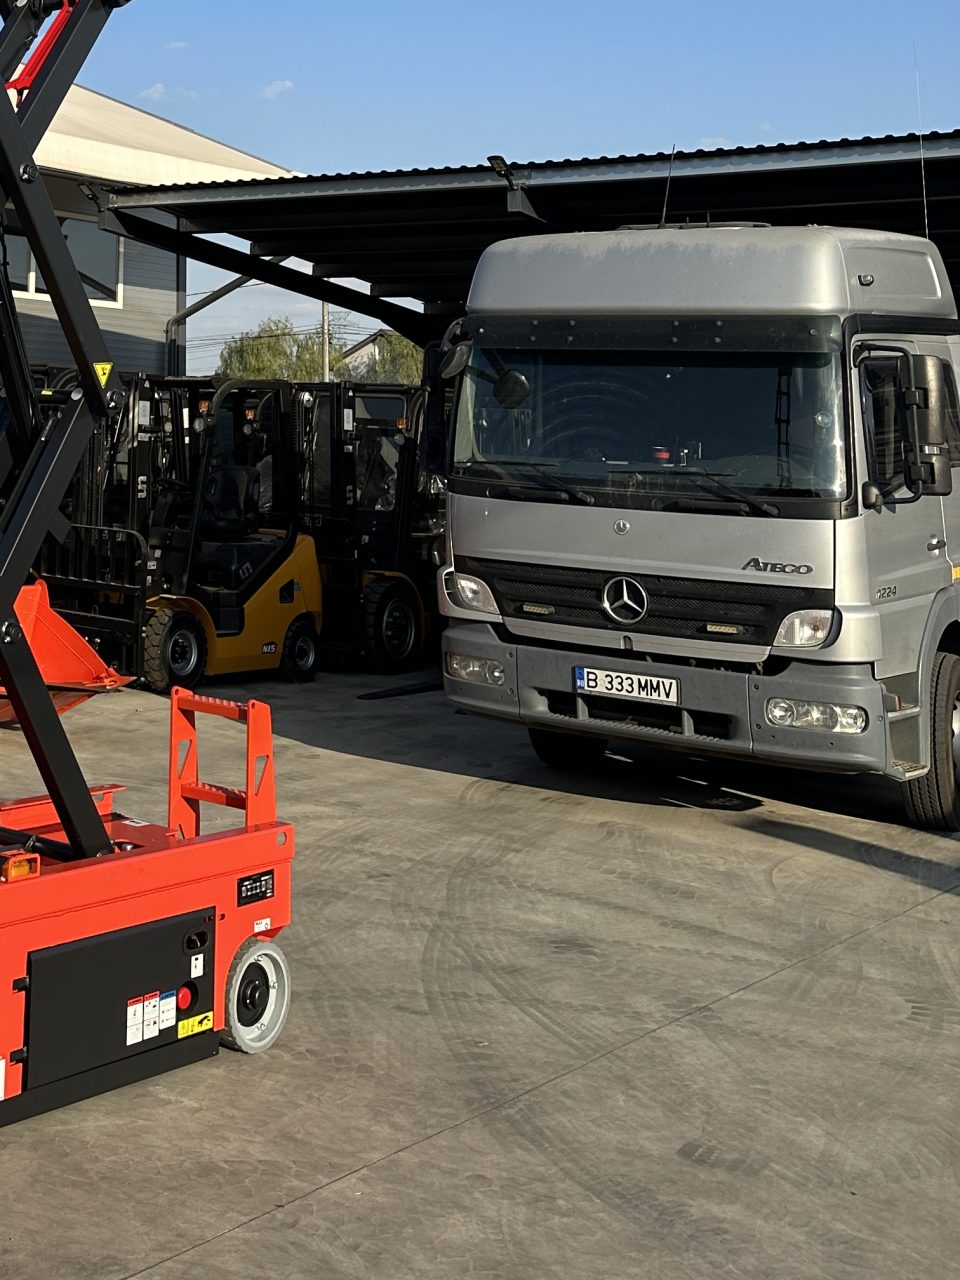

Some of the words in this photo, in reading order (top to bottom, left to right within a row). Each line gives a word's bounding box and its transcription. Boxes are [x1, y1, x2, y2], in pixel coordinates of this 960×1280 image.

[586, 671, 598, 689] B
[604, 674, 634, 694] 333
[638, 678, 673, 699] MMV
